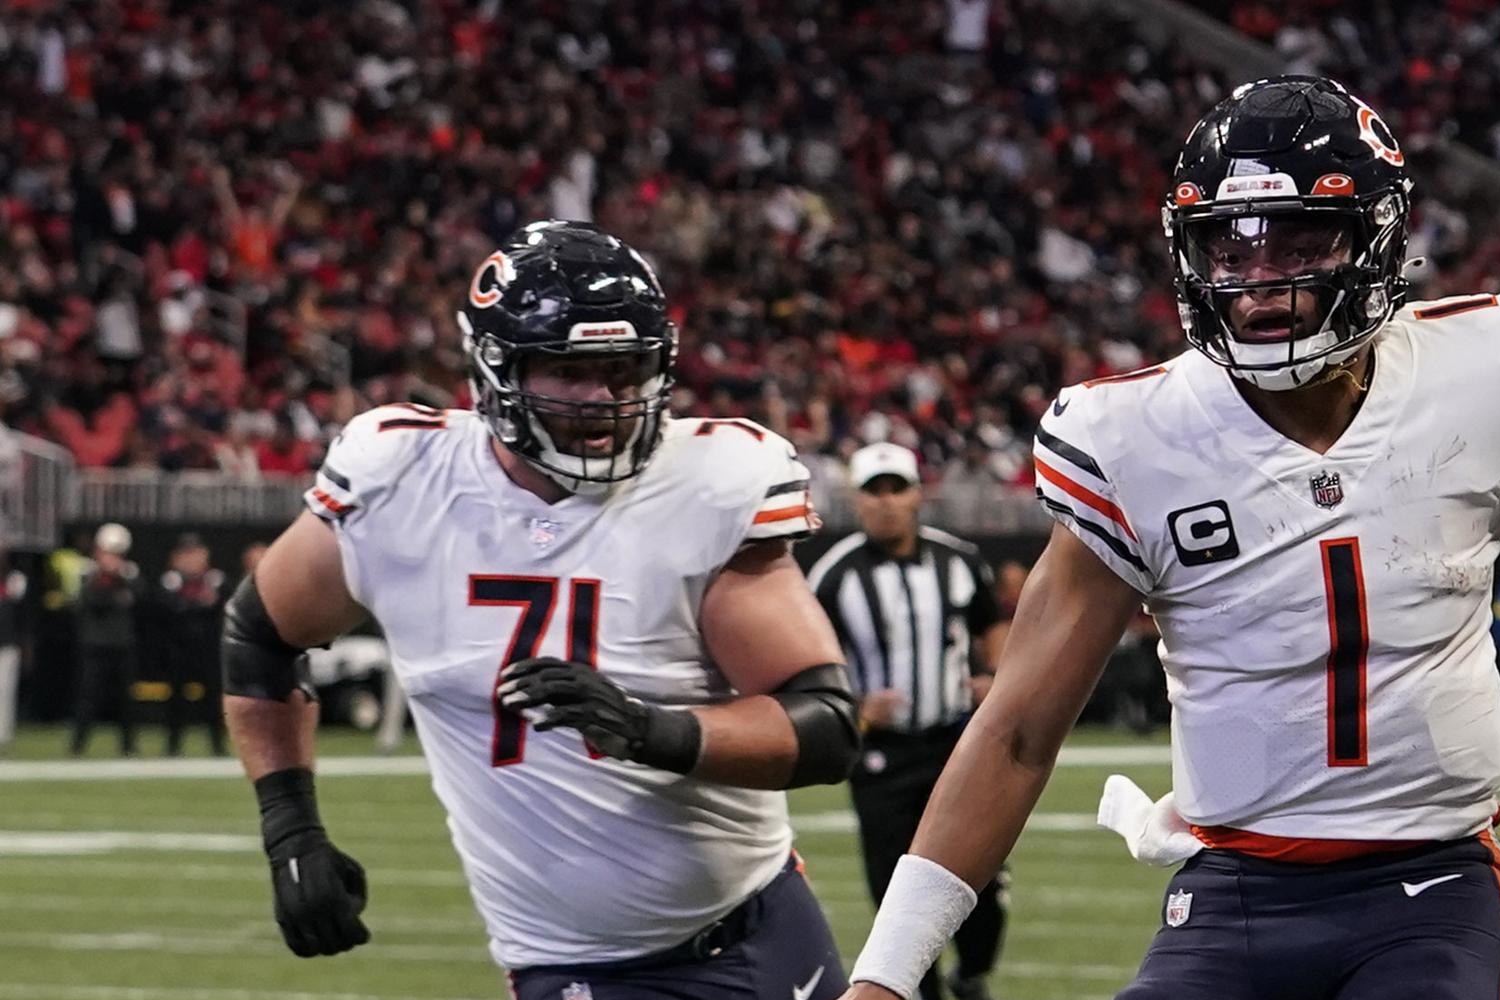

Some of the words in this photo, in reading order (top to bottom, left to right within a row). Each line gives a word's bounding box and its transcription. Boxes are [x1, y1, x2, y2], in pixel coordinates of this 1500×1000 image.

[1174, 505, 1231, 551] C
[1316, 487, 1341, 503] NFL
[468, 574, 602, 768] 71
[1319, 536, 1370, 768] 1
